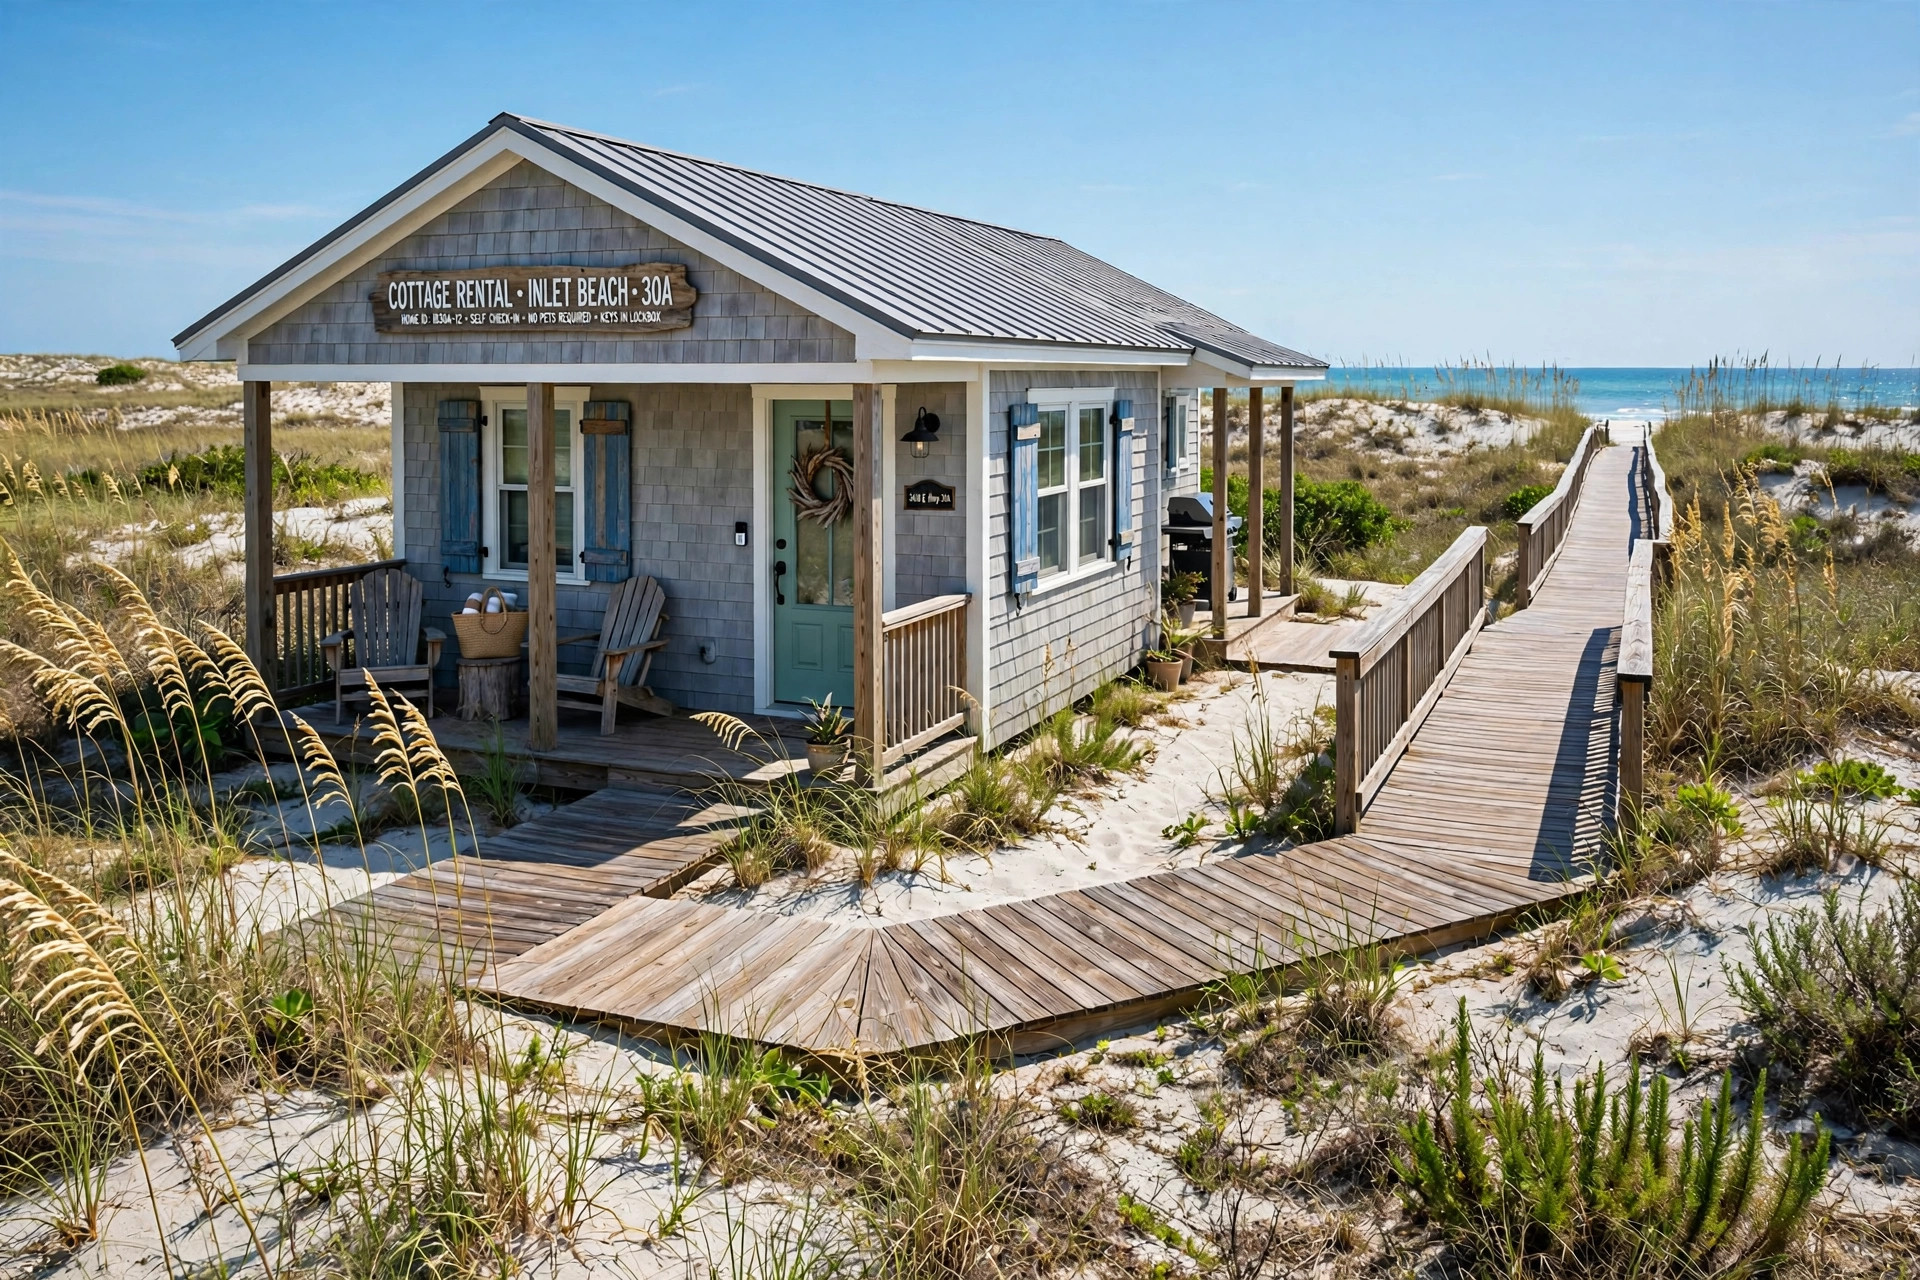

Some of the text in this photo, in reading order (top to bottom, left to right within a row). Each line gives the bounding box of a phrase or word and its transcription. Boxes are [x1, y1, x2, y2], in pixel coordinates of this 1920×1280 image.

[388, 275, 673, 310] COTTAGE RENTAL INLET BEACH 30A
[401, 313, 419, 325] HOME
[469, 313, 486, 325] SELF
[528, 312, 538, 323] NO
[539, 312, 556, 323] PETS
[558, 311, 591, 324] REQUIRED
[600, 311, 618, 323] KEYS
[621, 311, 628, 322] IN
[629, 310, 661, 323] LOCKBOX
